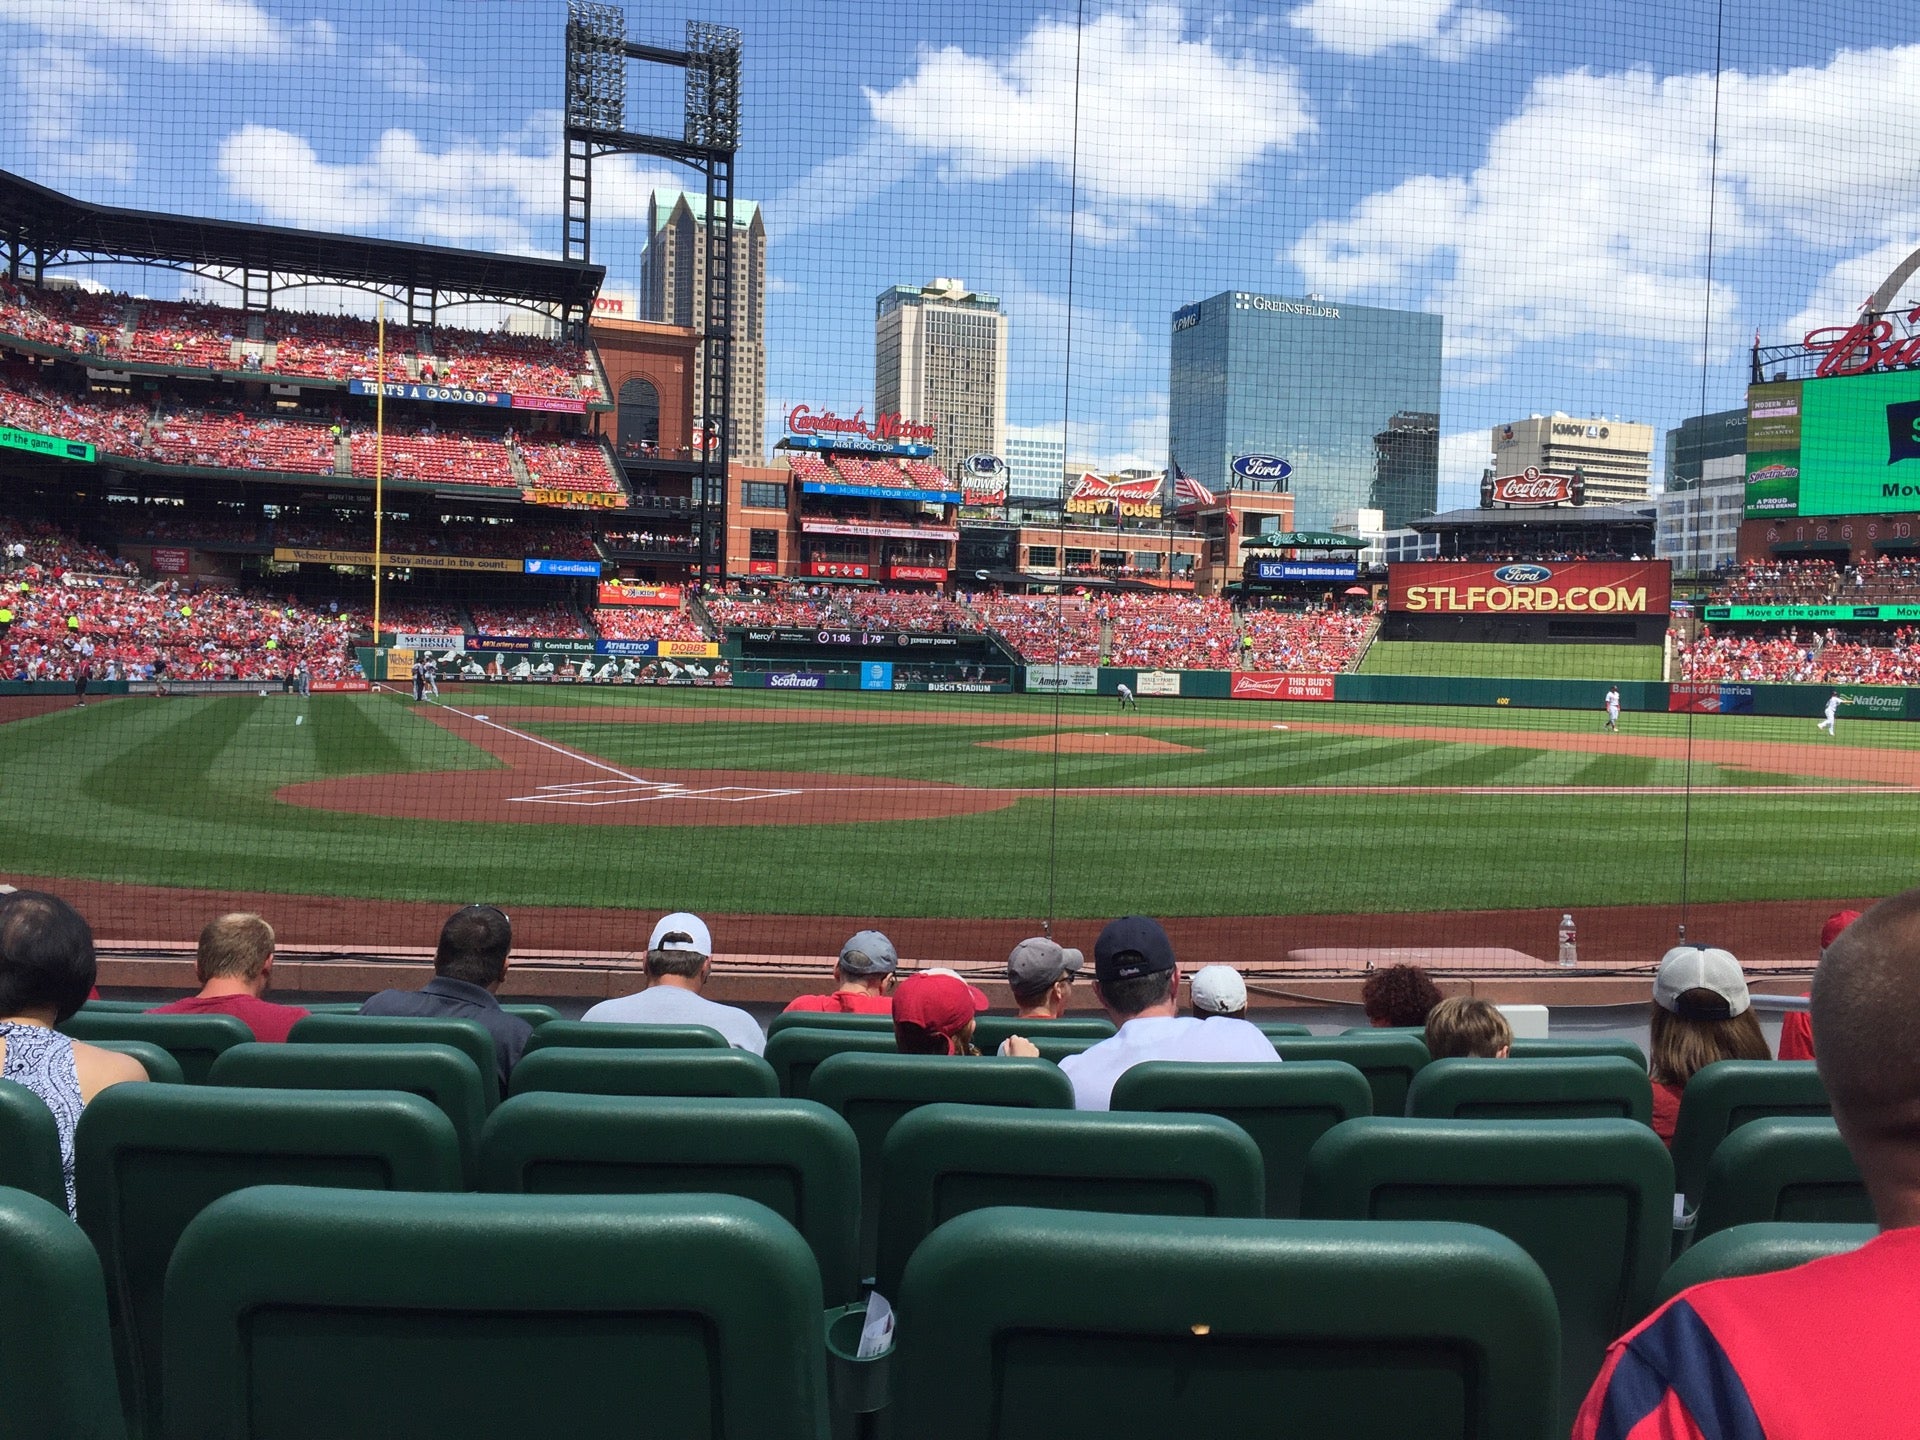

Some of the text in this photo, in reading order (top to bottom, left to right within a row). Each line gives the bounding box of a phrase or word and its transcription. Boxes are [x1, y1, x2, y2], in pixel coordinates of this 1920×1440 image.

[1253, 296, 1341, 319] GREENSFELDER
[1172, 313, 1197, 332] KPMG
[362, 382, 404, 397] THAT'S
[410, 385, 420, 398] A
[788, 404, 935, 440] Cardinals Nation
[1552, 422, 1585, 437] KMOV
[2, 432, 54, 450] of the game
[832, 440, 894, 452] AT&T ROOFTOP
[1245, 457, 1283, 477] Ford
[1748, 467, 1799, 484] Spectracide
[961, 477, 1009, 490] MIDWEST
[1067, 479, 1161, 500] Budweiser
[1502, 478, 1562, 498] Coca-Cola
[535, 489, 617, 508] BIG MAC
[881, 488, 901, 498] YOUR
[1066, 499, 1109, 515] BREW
[1816, 525, 1828, 541] 2
[1892, 522, 1911, 539] 10
[292, 550, 508, 570] Webster University Stay ahead in the count.
[1263, 565, 1281, 576] BJC
[1285, 567, 1307, 577] Making
[1307, 567, 1335, 576] Medicine
[1503, 565, 1540, 582] Ford
[1405, 586, 1647, 612] STLFORD.COM
[1746, 608, 1836, 619] Move of the game
[1897, 607, 1920, 617] Mov
[749, 631, 771, 642] Mercy
[832, 633, 851, 643] 1:06
[910, 637, 933, 645] JIMMY
[544, 641, 595, 652] Central Bank
[604, 641, 650, 651] ATHLETICO
[670, 643, 707, 652] DOBBS
[388, 653, 414, 665] Webster
[770, 673, 819, 688] Scottrade
[1038, 676, 1069, 686] Ameren
[1239, 680, 1281, 689] Budweiser
[1288, 677, 1332, 687] THIS BUD'S
[928, 682, 991, 692] BUSCH STADIUM
[1288, 687, 1324, 696] FOR YOU.
[1672, 684, 1752, 696] Bank of America
[1853, 695, 1904, 706] National
